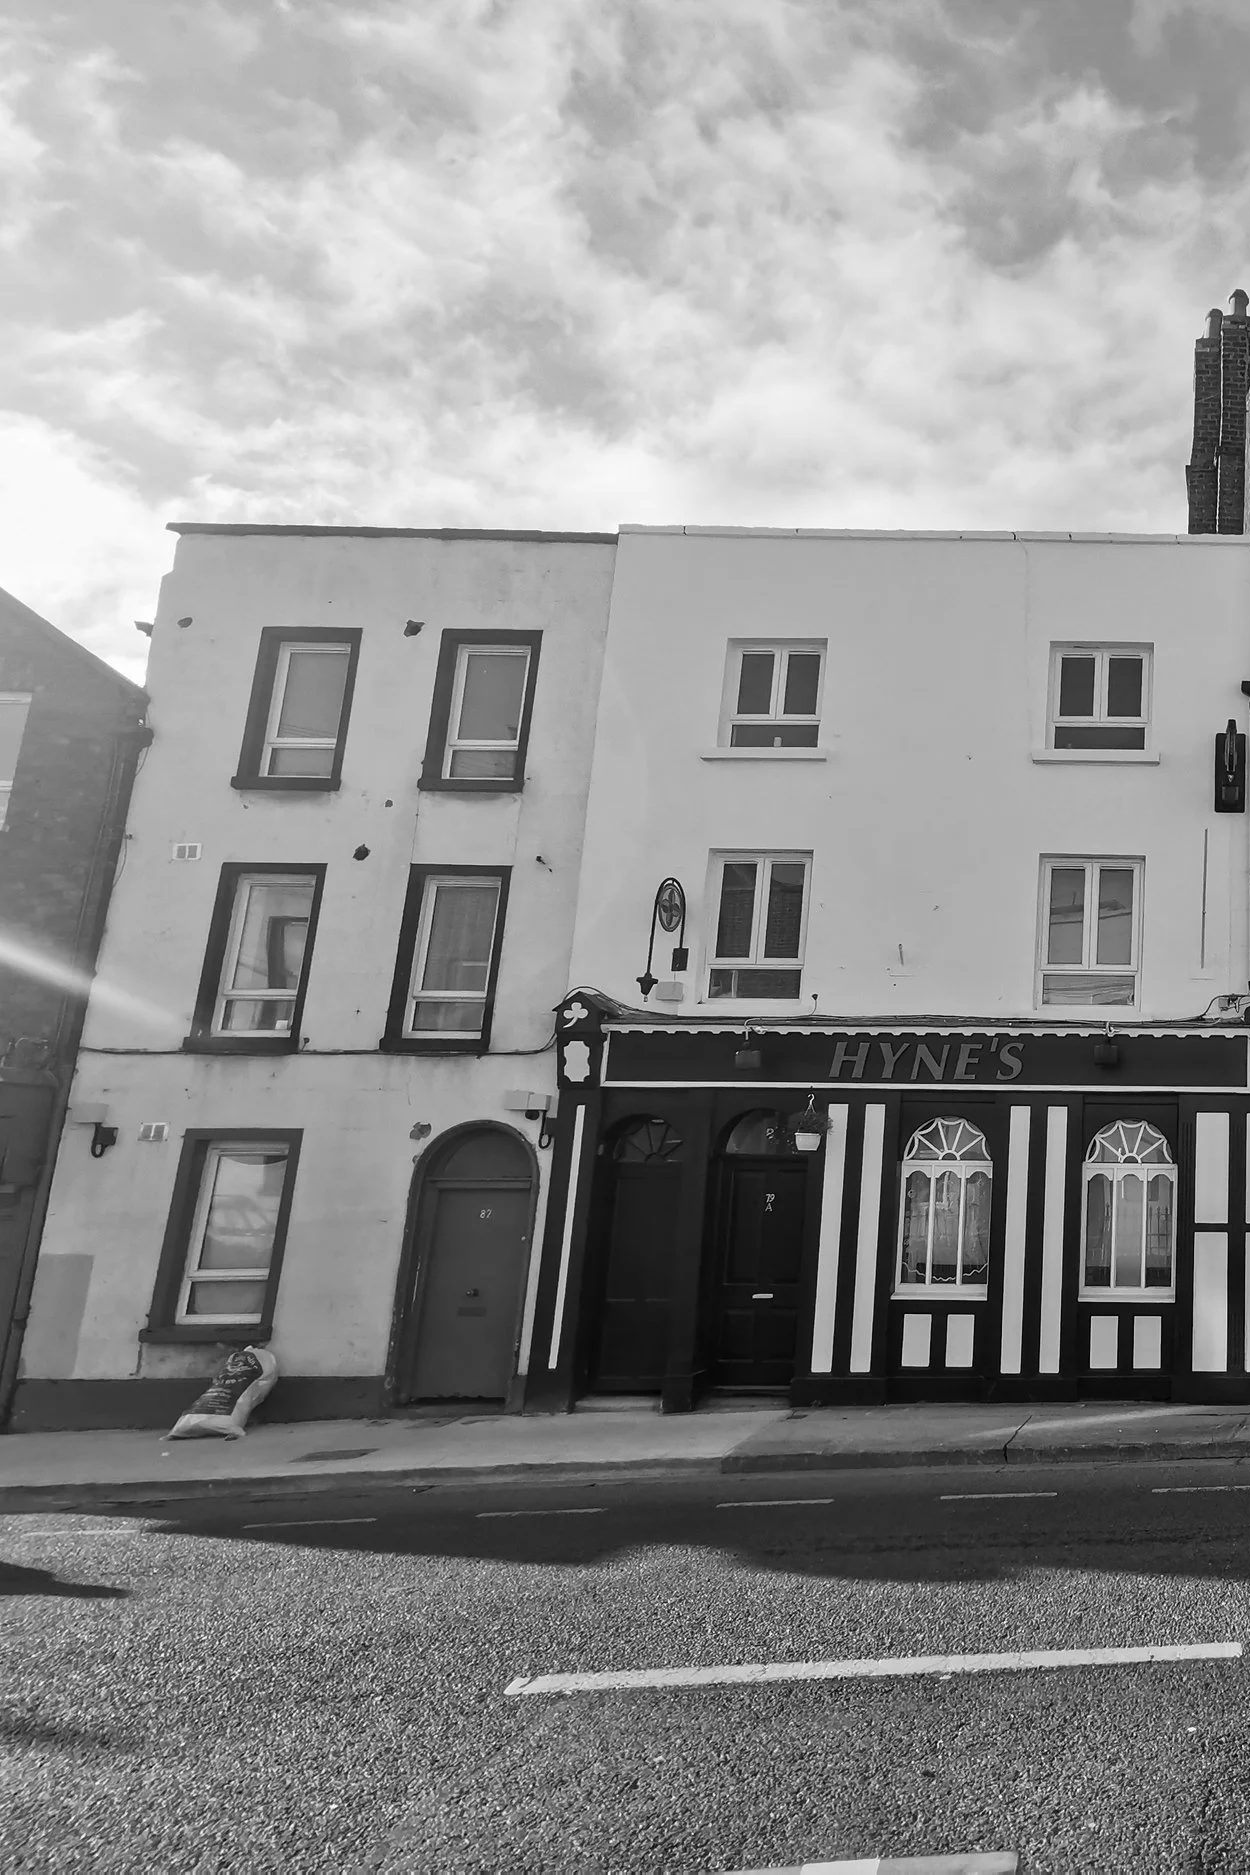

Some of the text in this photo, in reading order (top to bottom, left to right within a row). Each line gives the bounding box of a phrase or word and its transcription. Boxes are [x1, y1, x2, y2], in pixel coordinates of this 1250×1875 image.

[828, 1037, 1025, 1081] HYNE'S
[765, 1193, 776, 1203] 79
[765, 1203, 773, 1212] A
